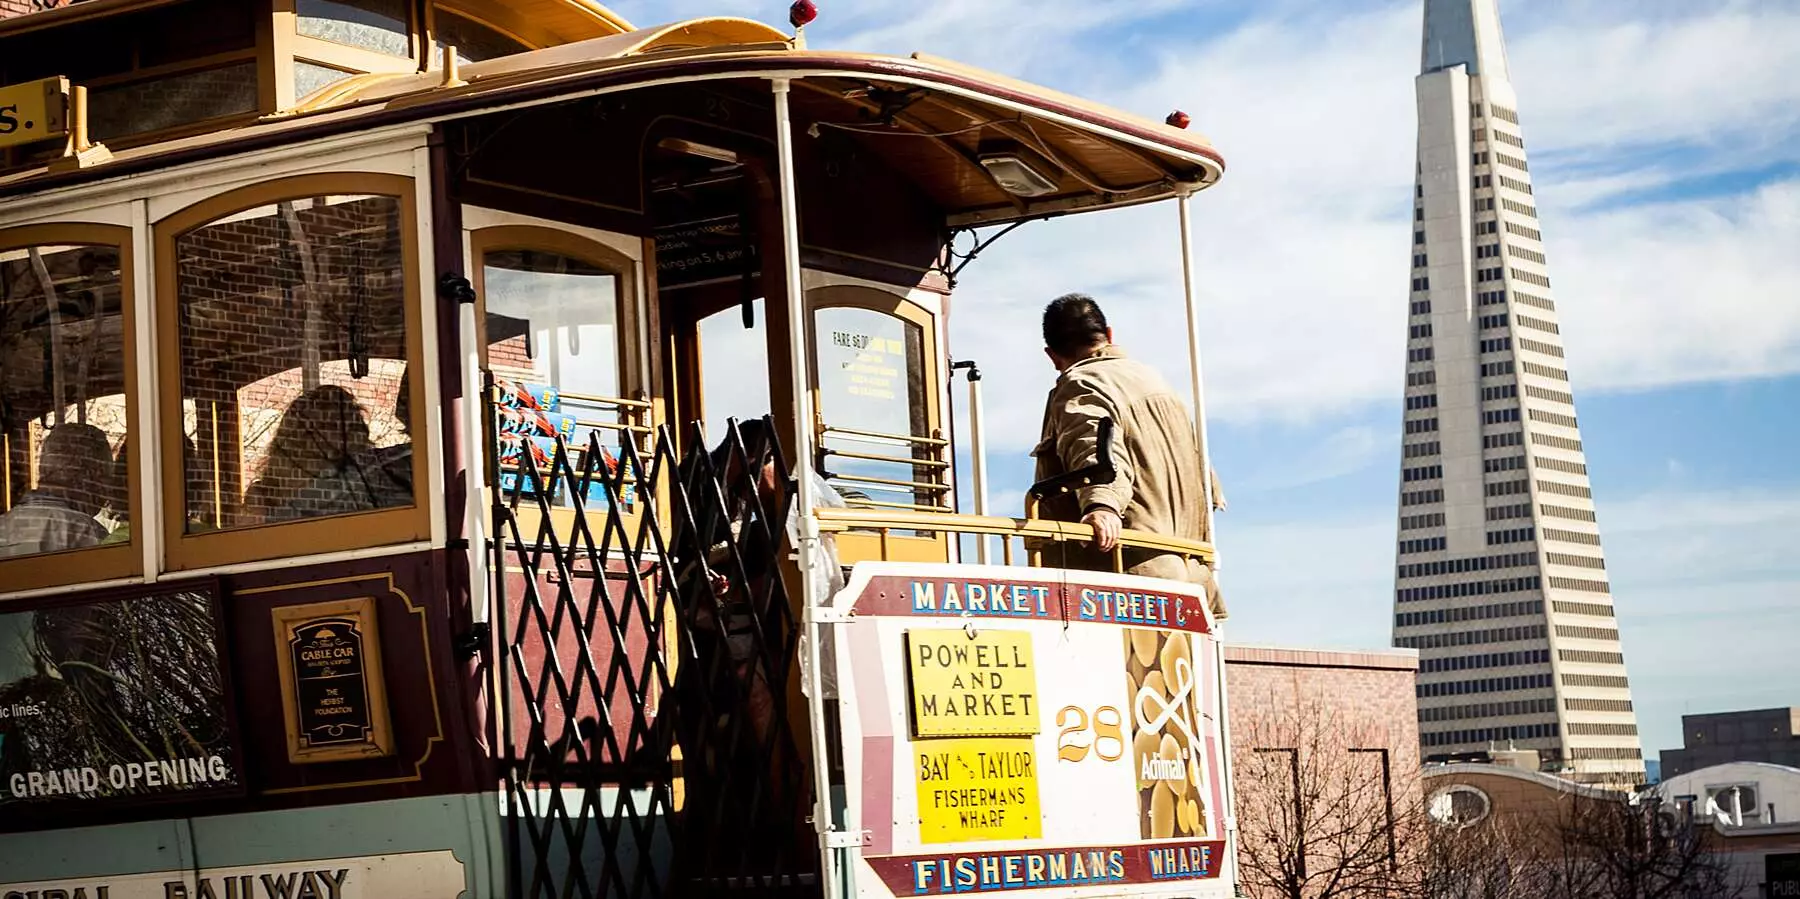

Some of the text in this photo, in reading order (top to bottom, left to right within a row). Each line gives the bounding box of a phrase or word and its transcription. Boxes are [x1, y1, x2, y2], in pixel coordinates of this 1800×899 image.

[912, 580, 1049, 616] MARKET
[1080, 588, 1168, 625] STREET
[301, 647, 353, 660] CABLE CAR
[919, 644, 1027, 668] POWELL
[952, 672, 1003, 690] AND
[921, 694, 1032, 717] MARKET
[1056, 705, 1124, 763] 28
[9, 754, 226, 798] GRAND OPENING
[921, 753, 950, 781] BAY
[978, 751, 1032, 779] TAYLOR
[934, 787, 1025, 808] FISHERMANS
[959, 809, 1005, 828] WHARF
[912, 846, 1210, 893] FISHERMANS WHARF
